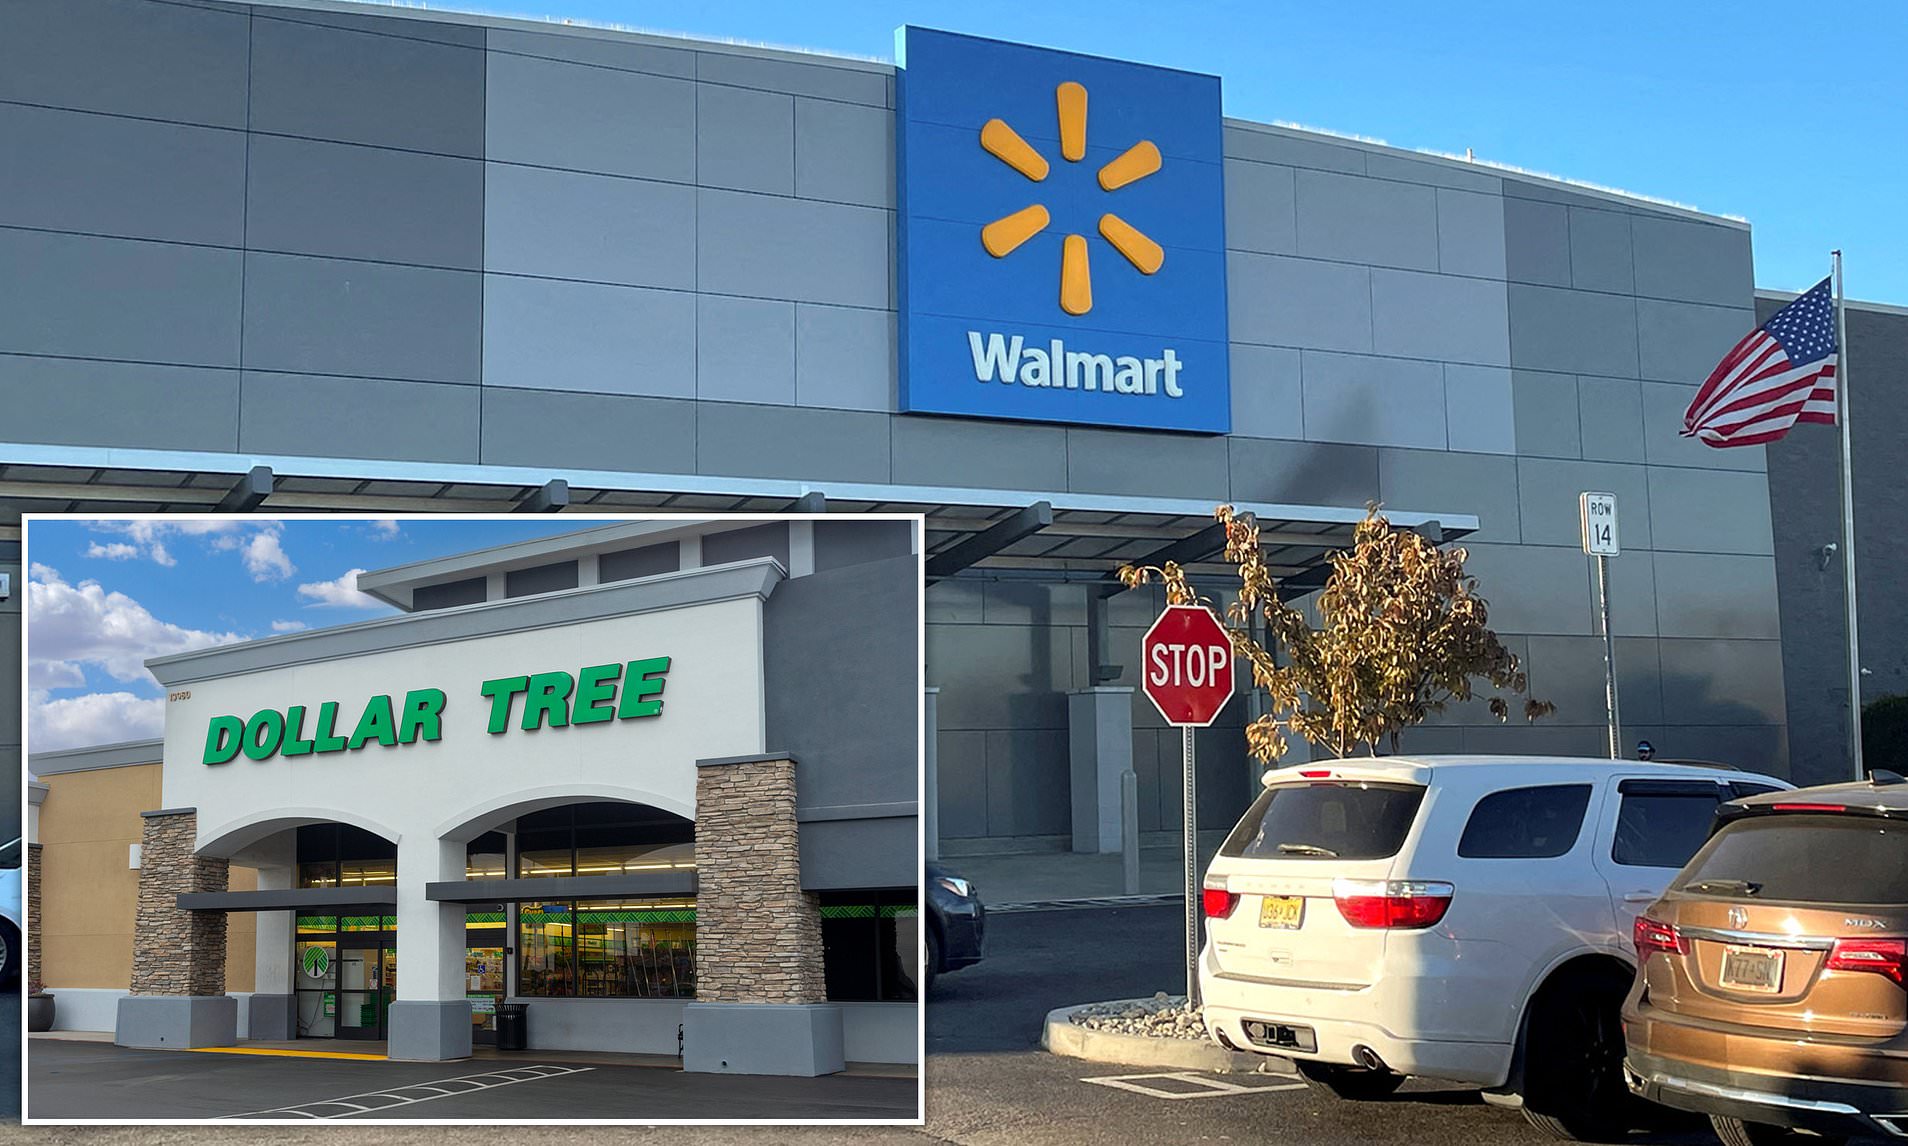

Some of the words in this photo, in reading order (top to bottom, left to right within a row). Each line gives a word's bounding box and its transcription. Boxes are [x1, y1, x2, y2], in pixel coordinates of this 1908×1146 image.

[967, 331, 1184, 397] Walmart
[1591, 502, 1612, 516] ROW
[1595, 524, 1611, 546] 14
[1150, 642, 1227, 688] STOP
[202, 687, 448, 766] DOLLAR
[480, 656, 672, 735] TREE
[1844, 918, 1888, 929] MDX
